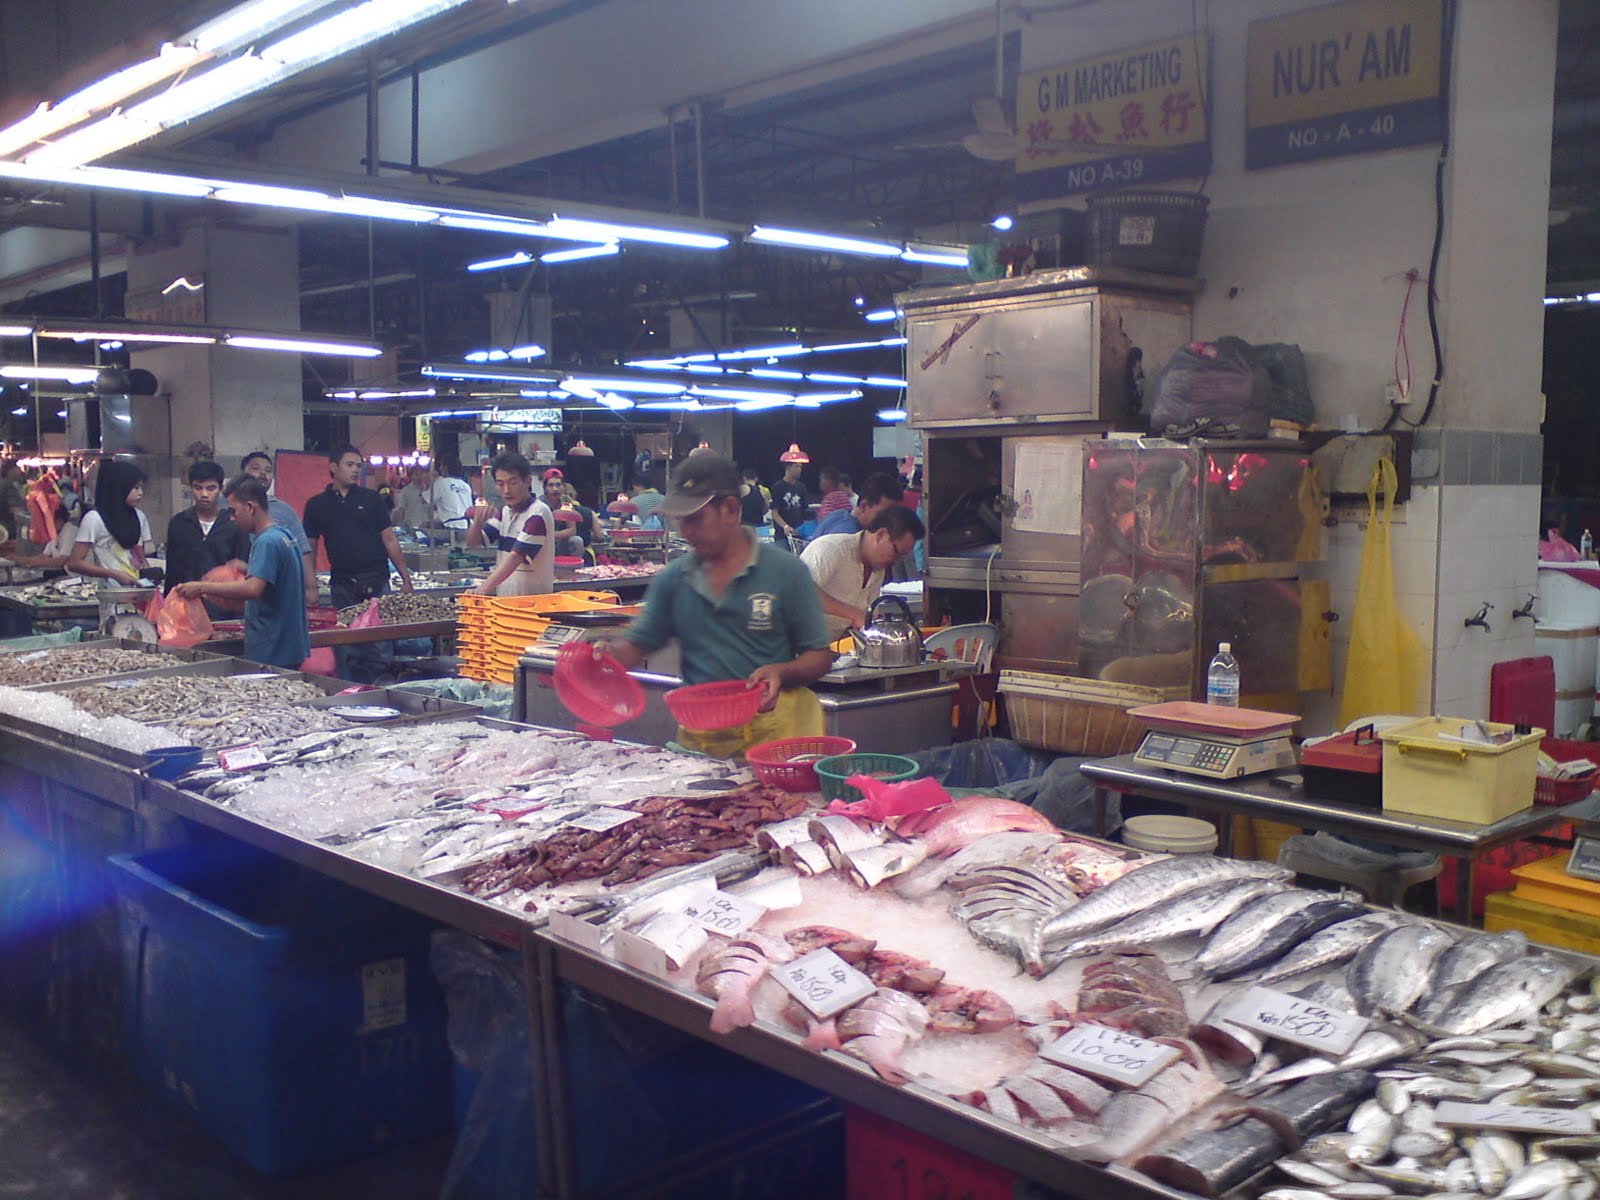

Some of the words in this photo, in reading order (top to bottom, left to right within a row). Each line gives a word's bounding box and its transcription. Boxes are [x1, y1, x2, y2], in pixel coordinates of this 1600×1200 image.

[1038, 76, 1051, 112] G
[1055, 72, 1070, 111] M
[1074, 48, 1182, 105] MARKETING
[1288, 128, 1319, 149] NO
[1370, 114, 1395, 135] 40
[1068, 166, 1096, 189] NO
[1101, 158, 1144, 182] A-39
